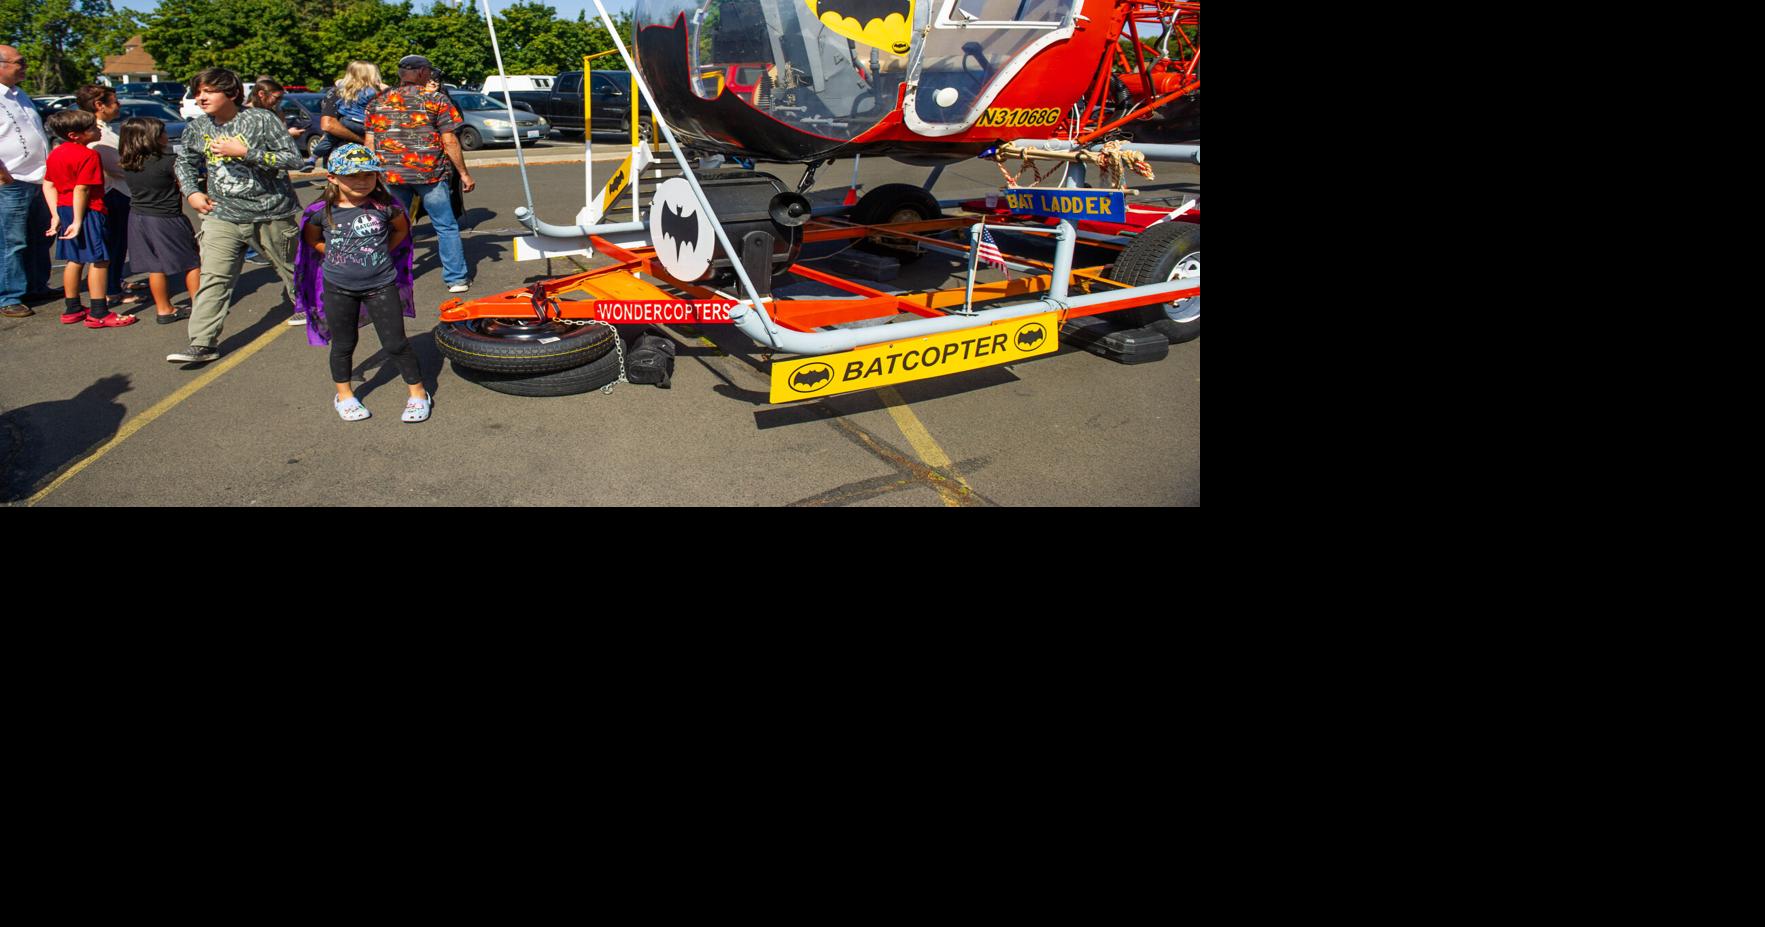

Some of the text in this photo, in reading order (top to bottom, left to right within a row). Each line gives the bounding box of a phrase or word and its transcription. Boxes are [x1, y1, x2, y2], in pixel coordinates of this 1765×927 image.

[977, 108, 1060, 127] N31068G
[1007, 193, 1112, 215] BAT LADDER
[597, 303, 731, 320] WONDERCOPTERS
[842, 333, 1008, 382] BATCOPTER
